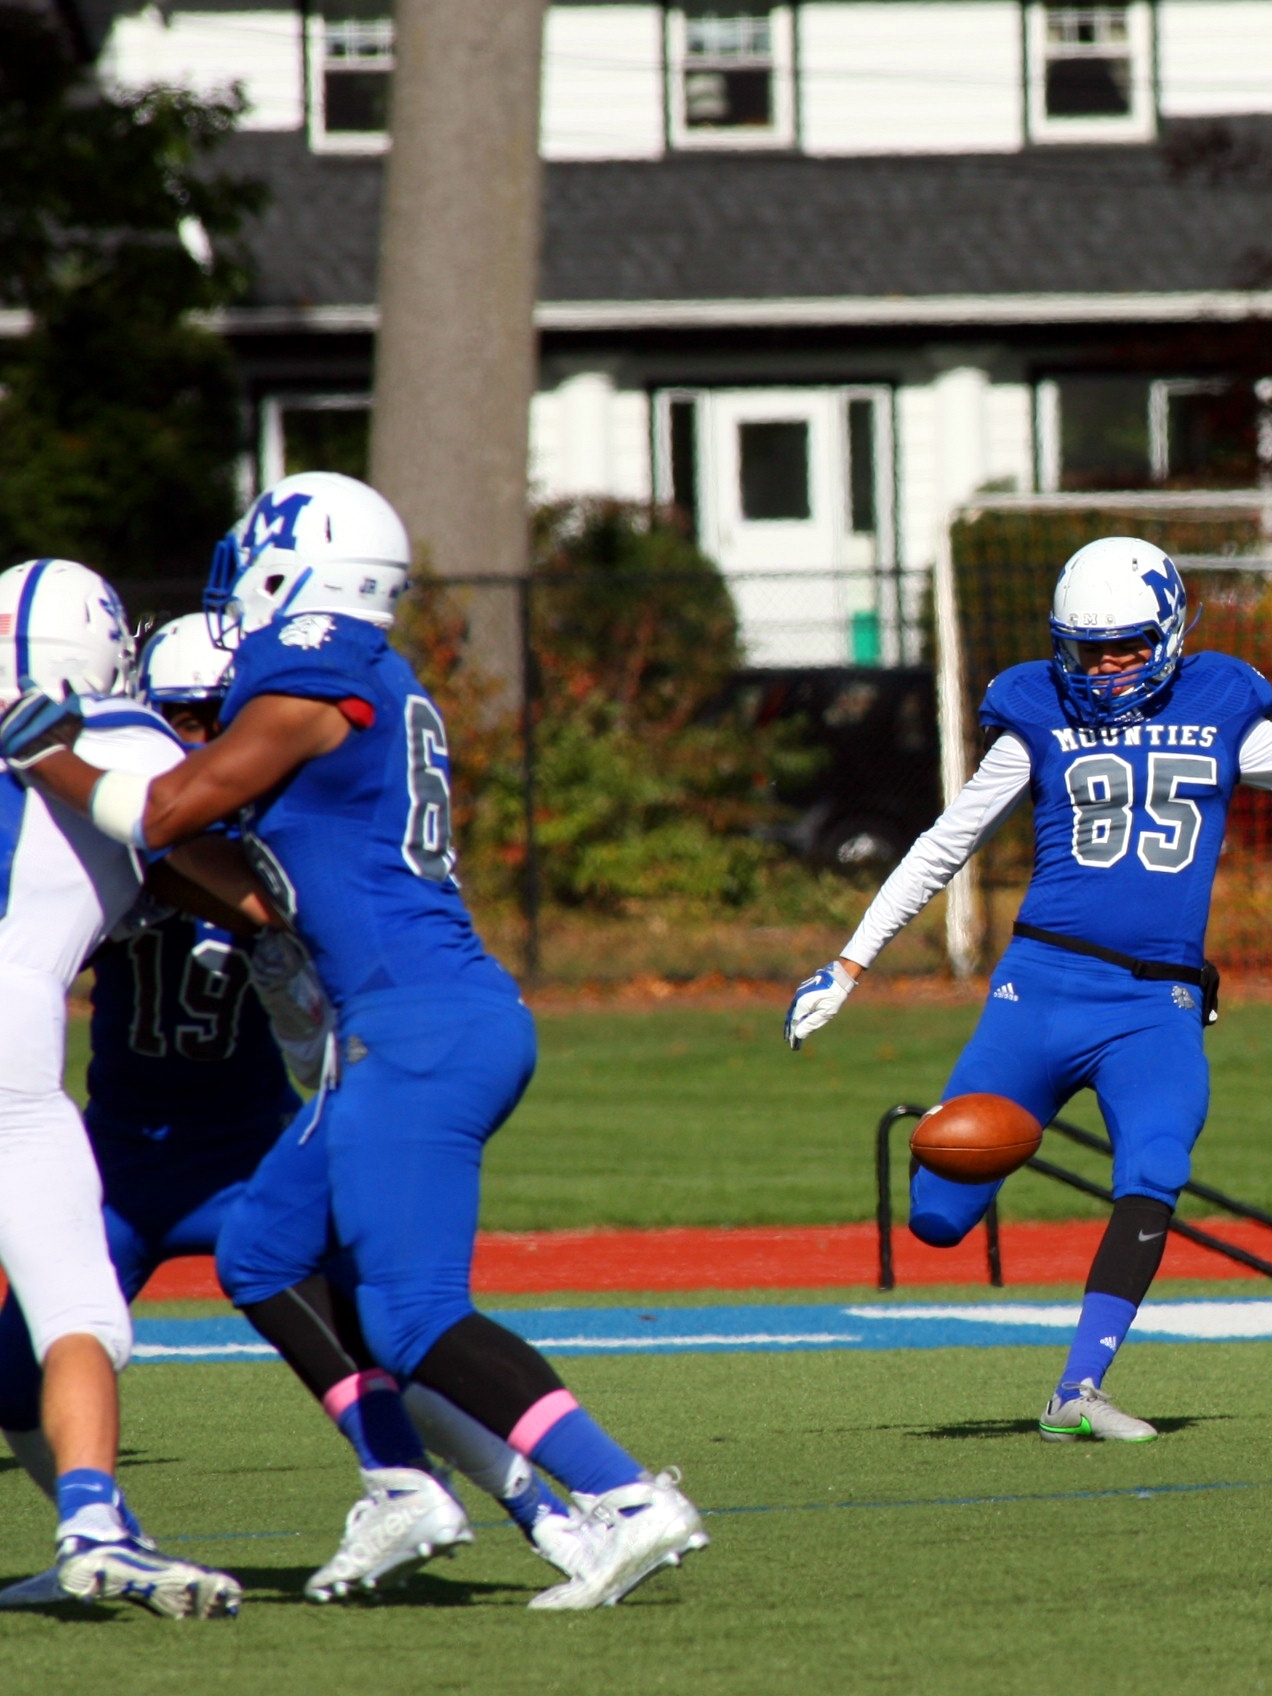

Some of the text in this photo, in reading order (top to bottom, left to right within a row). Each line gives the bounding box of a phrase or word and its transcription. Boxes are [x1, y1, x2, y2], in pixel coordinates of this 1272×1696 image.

[241, 491, 313, 550] M
[1141, 557, 1186, 624] M
[1051, 724, 1218, 752] MOUNTIES
[403, 694, 460, 888] 6
[1064, 752, 1217, 873] 85
[128, 929, 252, 1061] 19
